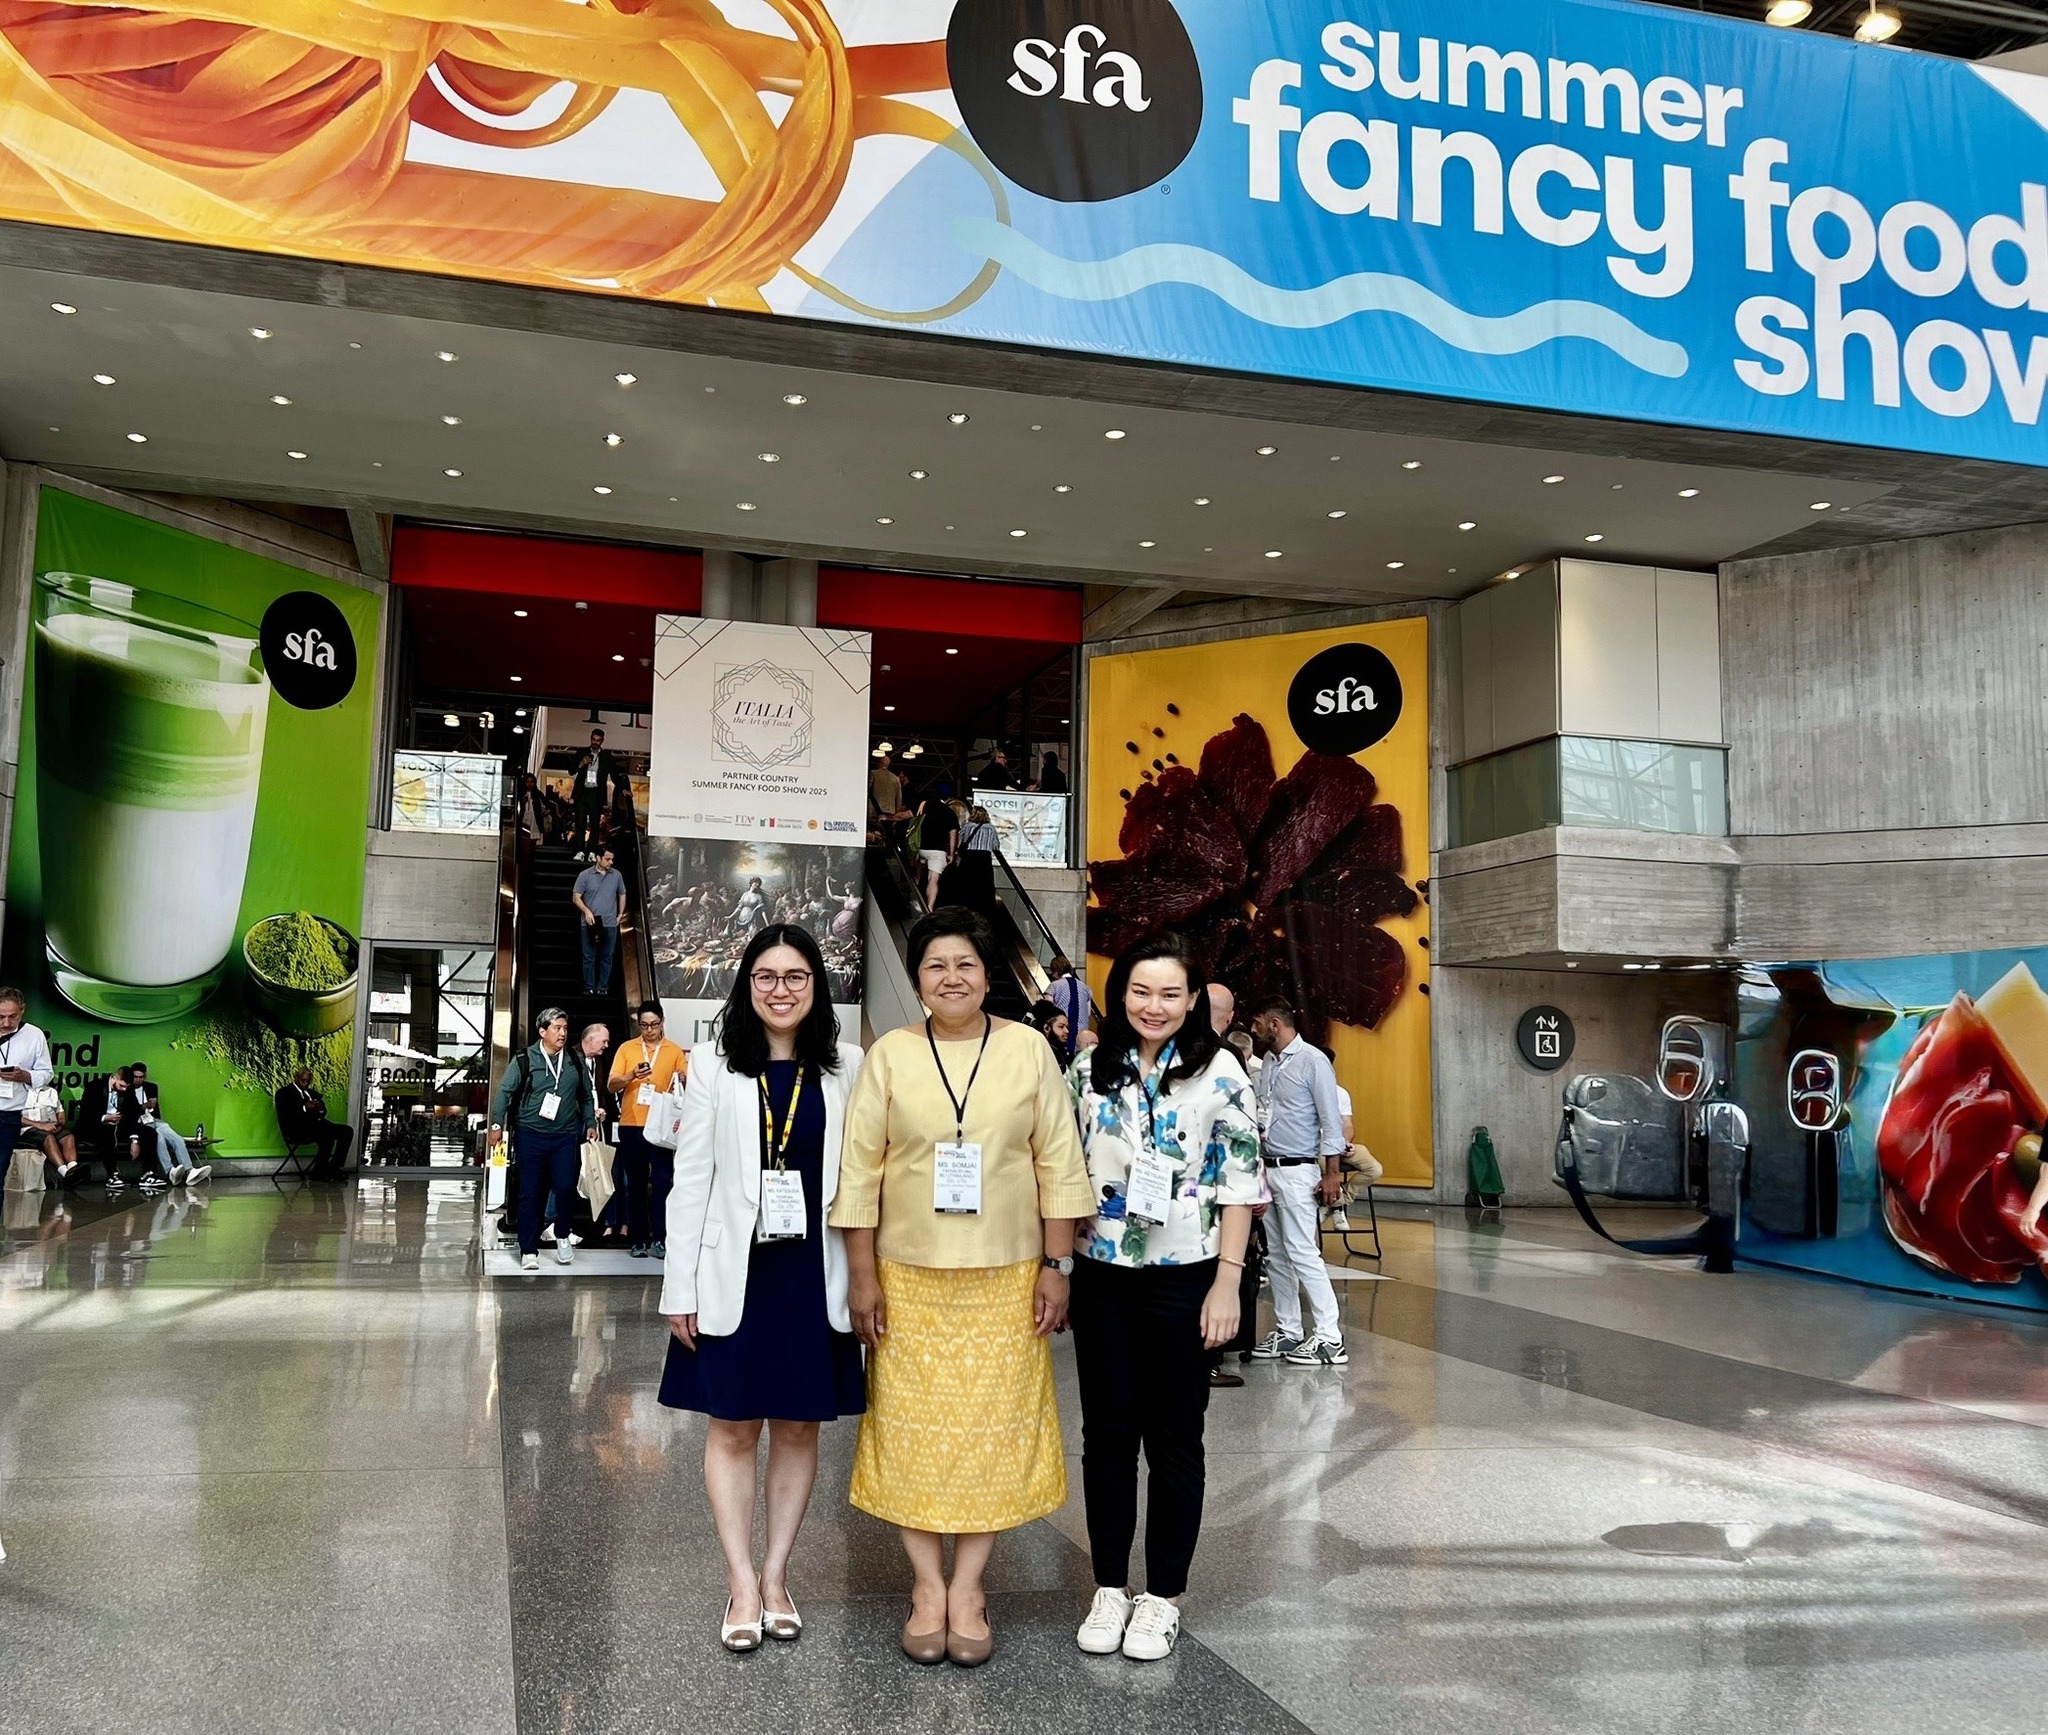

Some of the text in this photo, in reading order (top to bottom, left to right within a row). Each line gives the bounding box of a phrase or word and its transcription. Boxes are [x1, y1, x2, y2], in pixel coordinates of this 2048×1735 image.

[1006, 23, 1152, 112] sfa
[1319, 21, 1744, 148] summer
[1232, 58, 2048, 313] fancy food
[282, 628, 338, 671] sfa
[735, 701, 793, 718] ITALIA
[1313, 677, 1379, 715] sfa
[692, 780, 828, 796] SUMMER FANCY FOOD SHOW 2025
[722, 771, 799, 784] PARTNER COUNTRY
[980, 799, 1018, 810] TOOTSI
